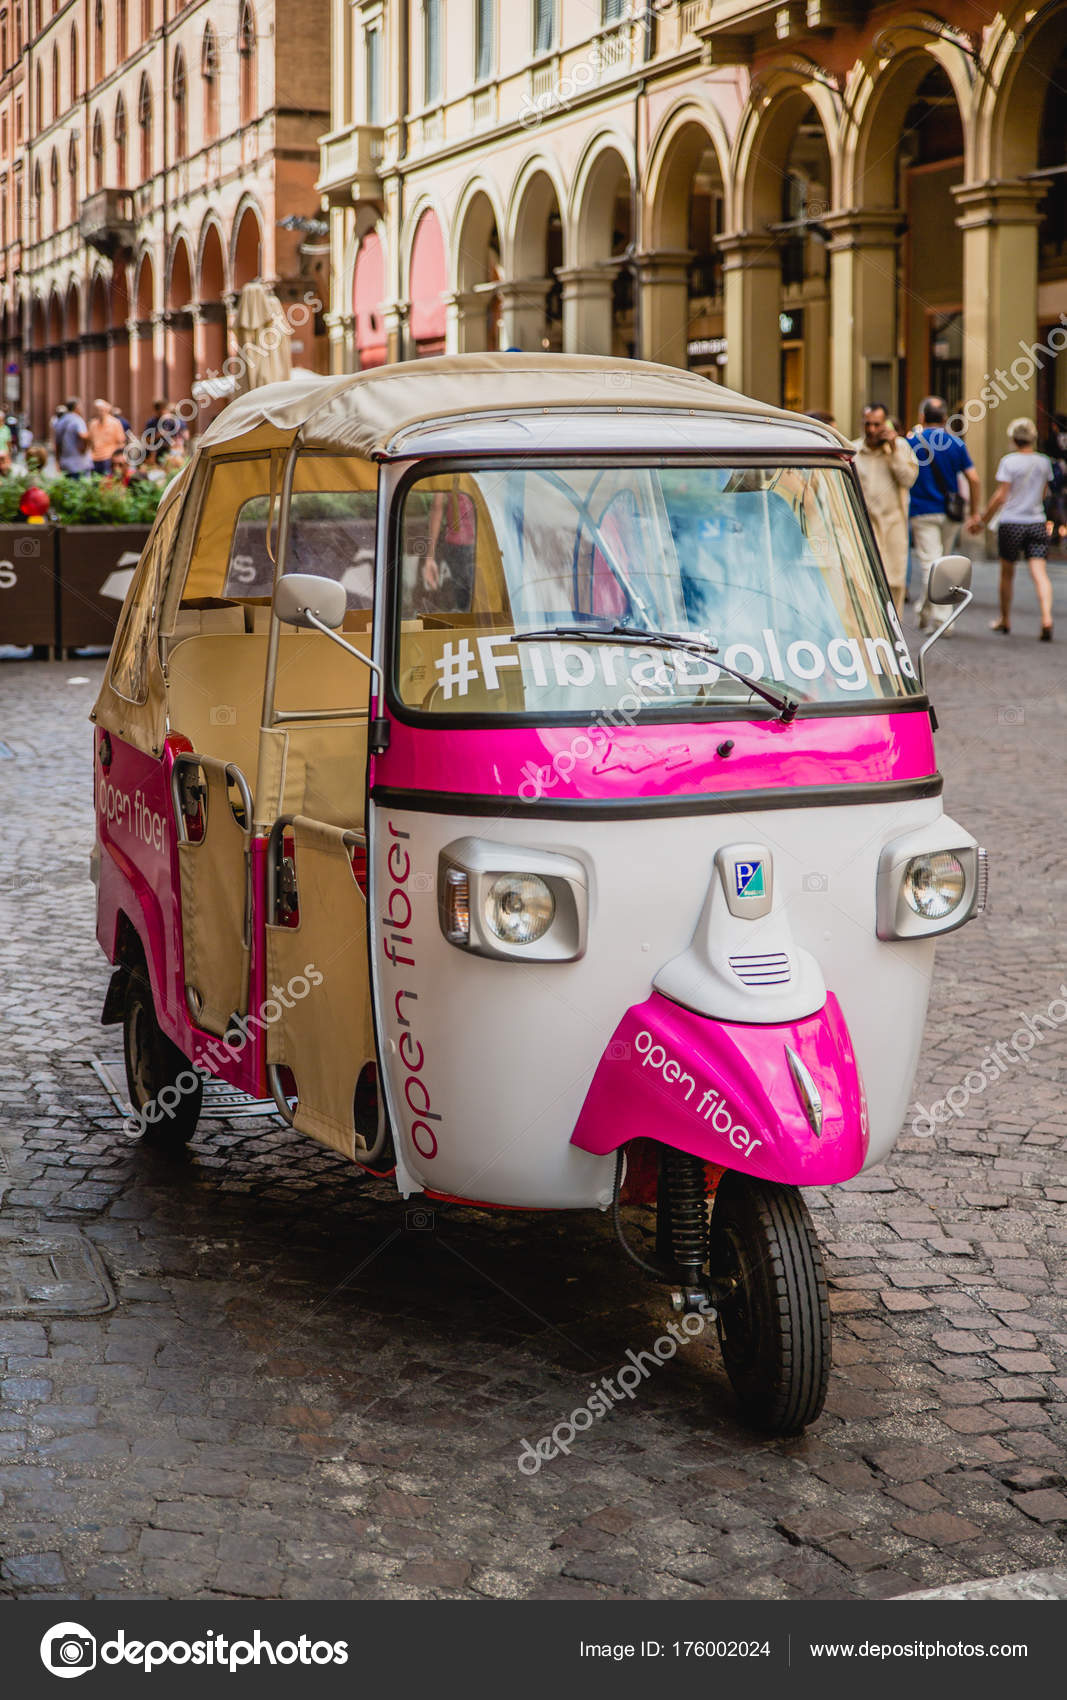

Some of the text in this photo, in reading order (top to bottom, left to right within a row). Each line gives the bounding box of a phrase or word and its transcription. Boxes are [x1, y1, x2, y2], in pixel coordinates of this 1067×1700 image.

[434, 628, 918, 700] #FibraBologna
[100, 779, 167, 856] open fiber
[382, 821, 442, 1160] open fiber
[635, 1031, 763, 1158] open fiber
